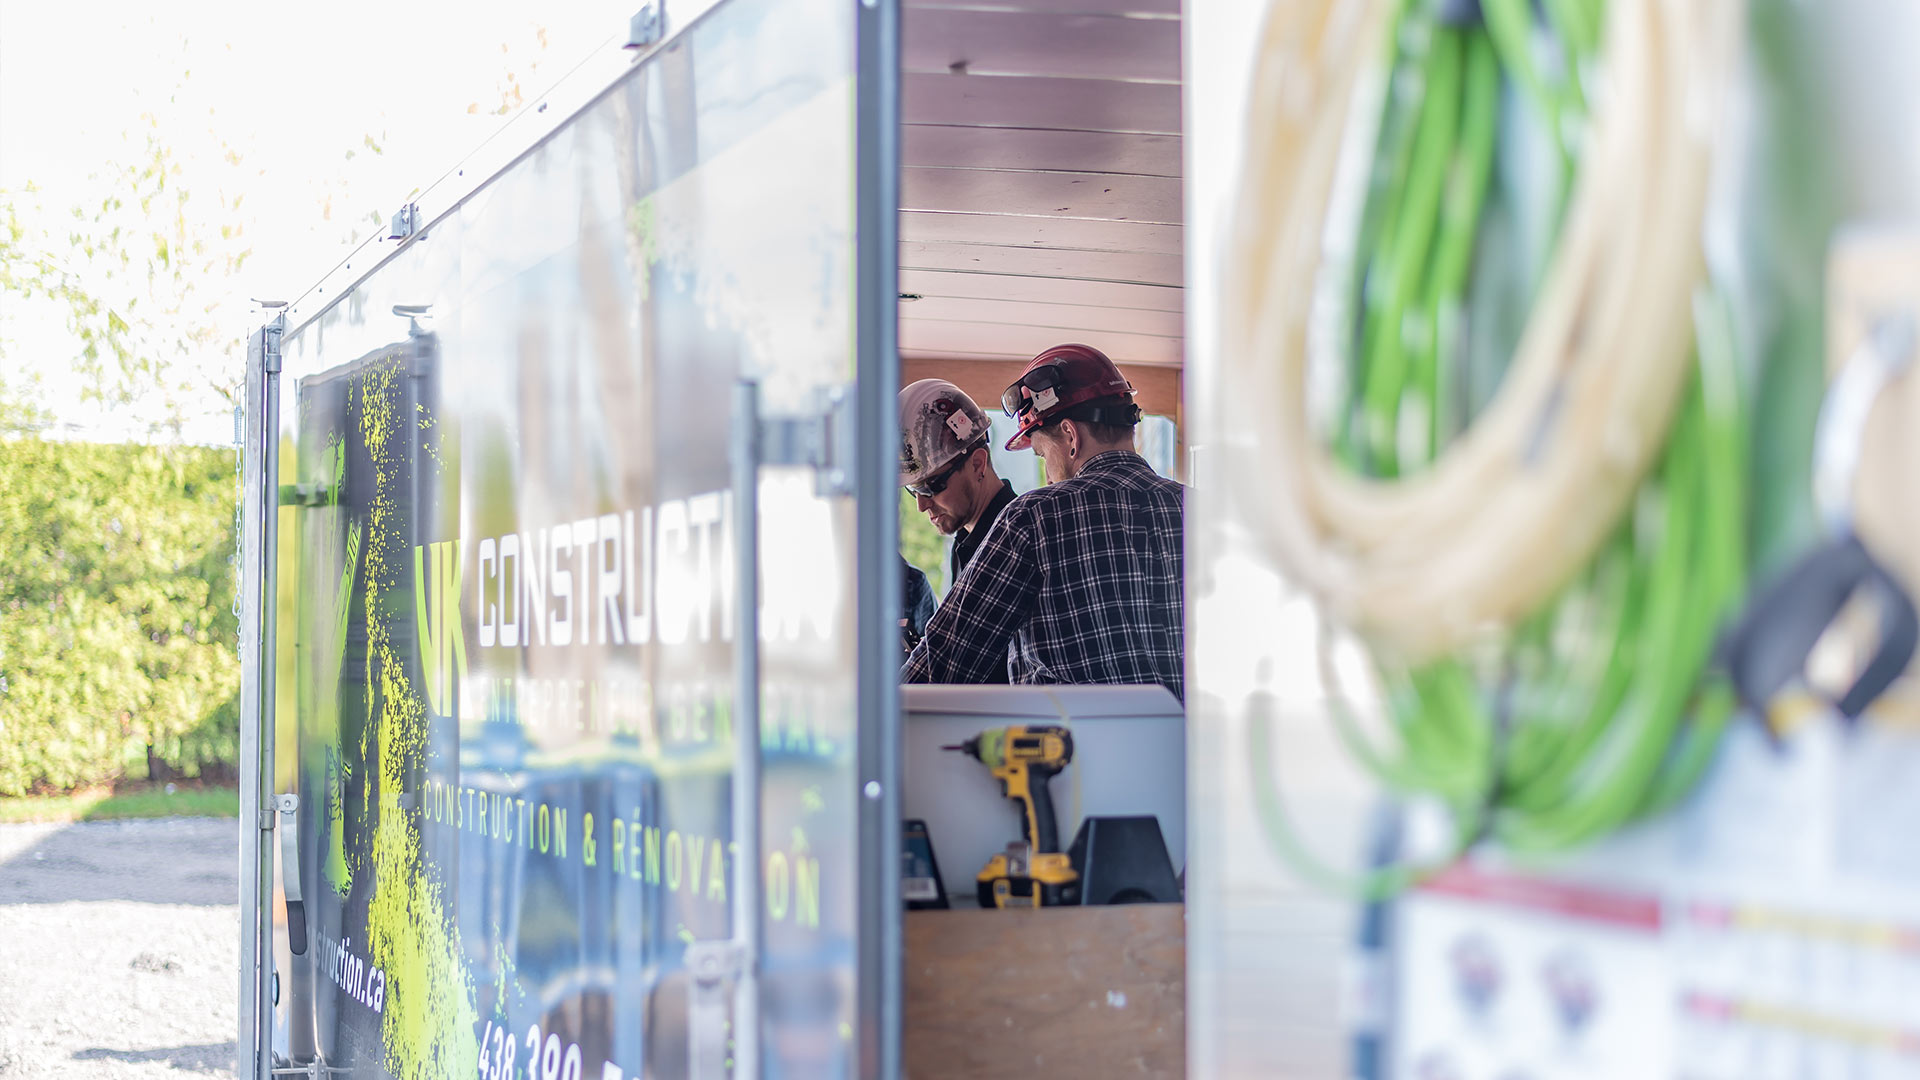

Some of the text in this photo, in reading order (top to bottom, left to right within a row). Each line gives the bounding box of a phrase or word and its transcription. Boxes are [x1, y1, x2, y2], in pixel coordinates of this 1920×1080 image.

[422, 779, 568, 859] CONSTRUCTION
[582, 812, 597, 867] &
[612, 805, 820, 929] RÉNOVAON
